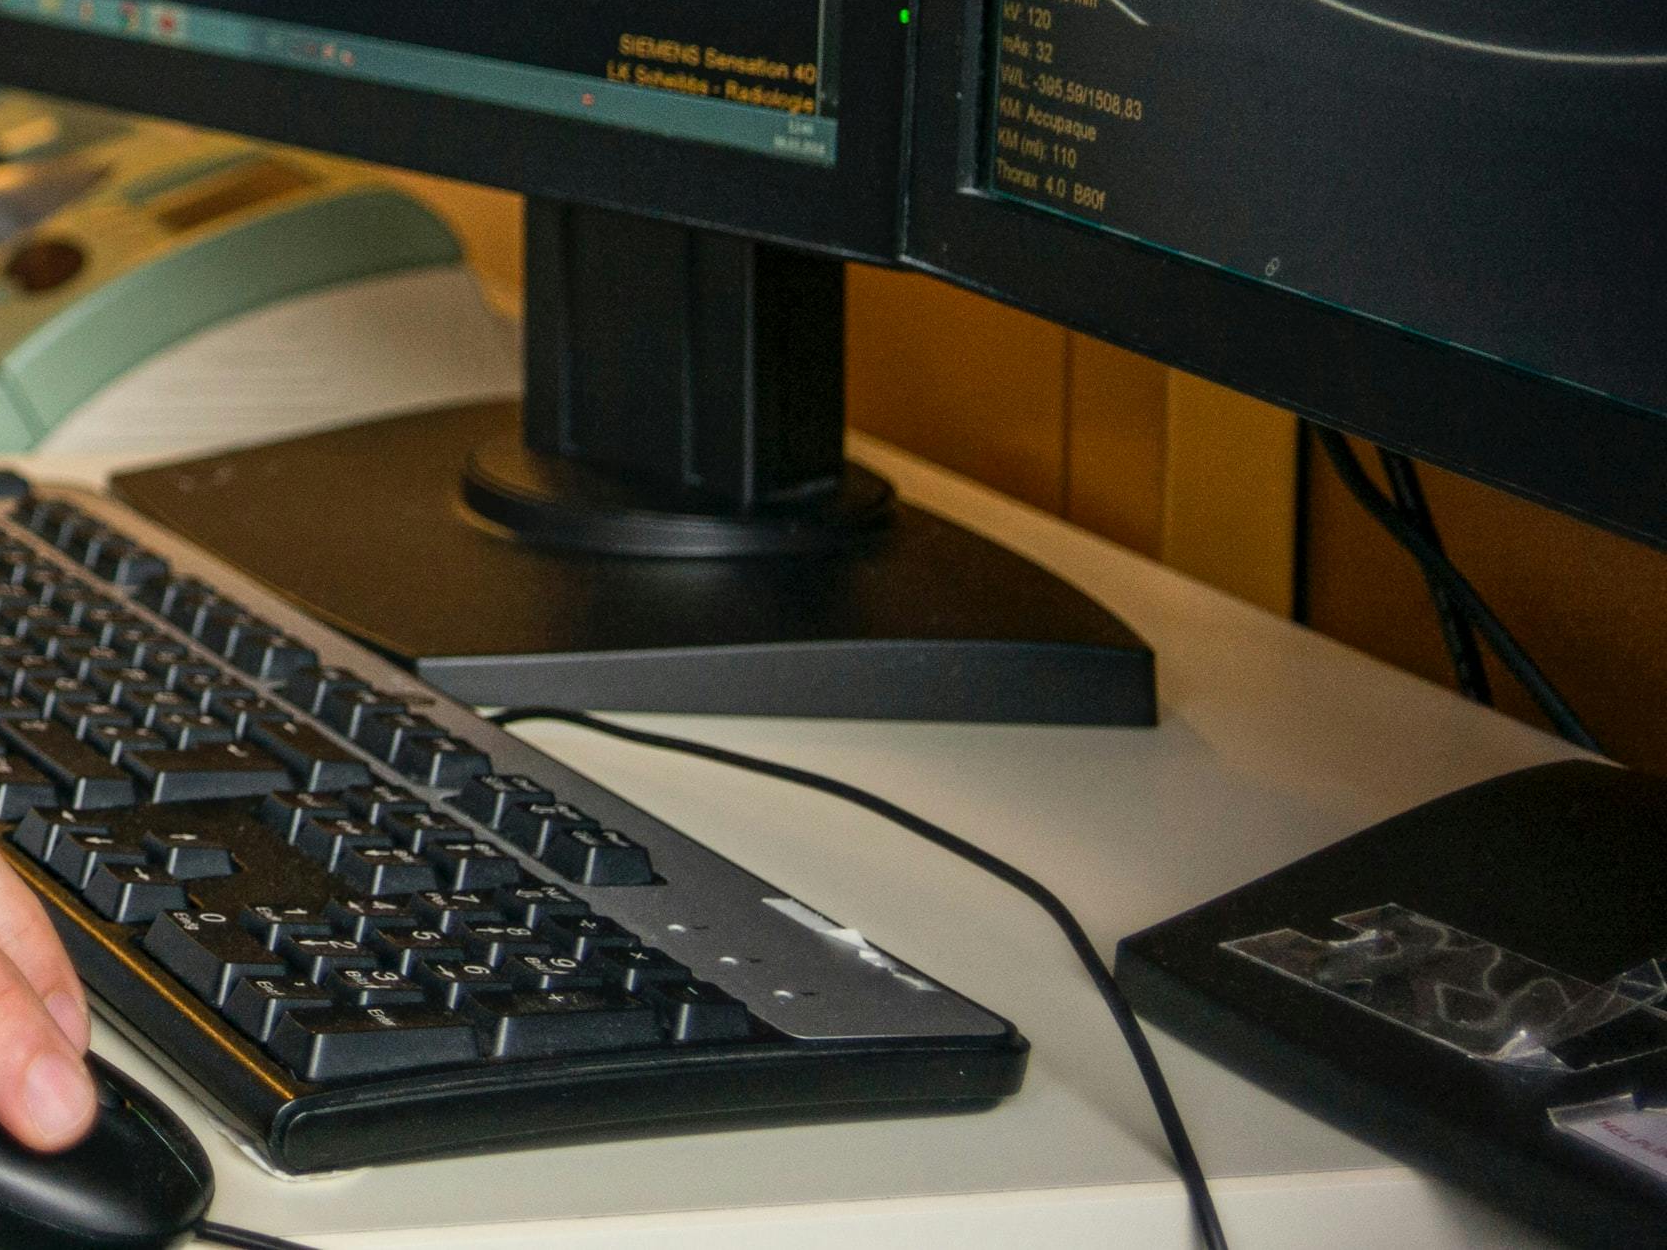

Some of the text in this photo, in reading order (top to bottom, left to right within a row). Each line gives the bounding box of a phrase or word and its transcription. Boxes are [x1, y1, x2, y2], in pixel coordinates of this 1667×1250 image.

[1029, 6, 1052, 30] 120
[618, 33, 701, 67] SIEMENS
[704, 46, 790, 80] Sensation
[1036, 40, 1054, 64] 32
[724, 78, 815, 116] Radiologie
[1052, 143, 1078, 169] 110
[996, 156, 1038, 190] Thorax
[1073, 182, 1107, 211] B60f
[198, 912, 227, 923] 0
[371, 970, 400, 982] 3
